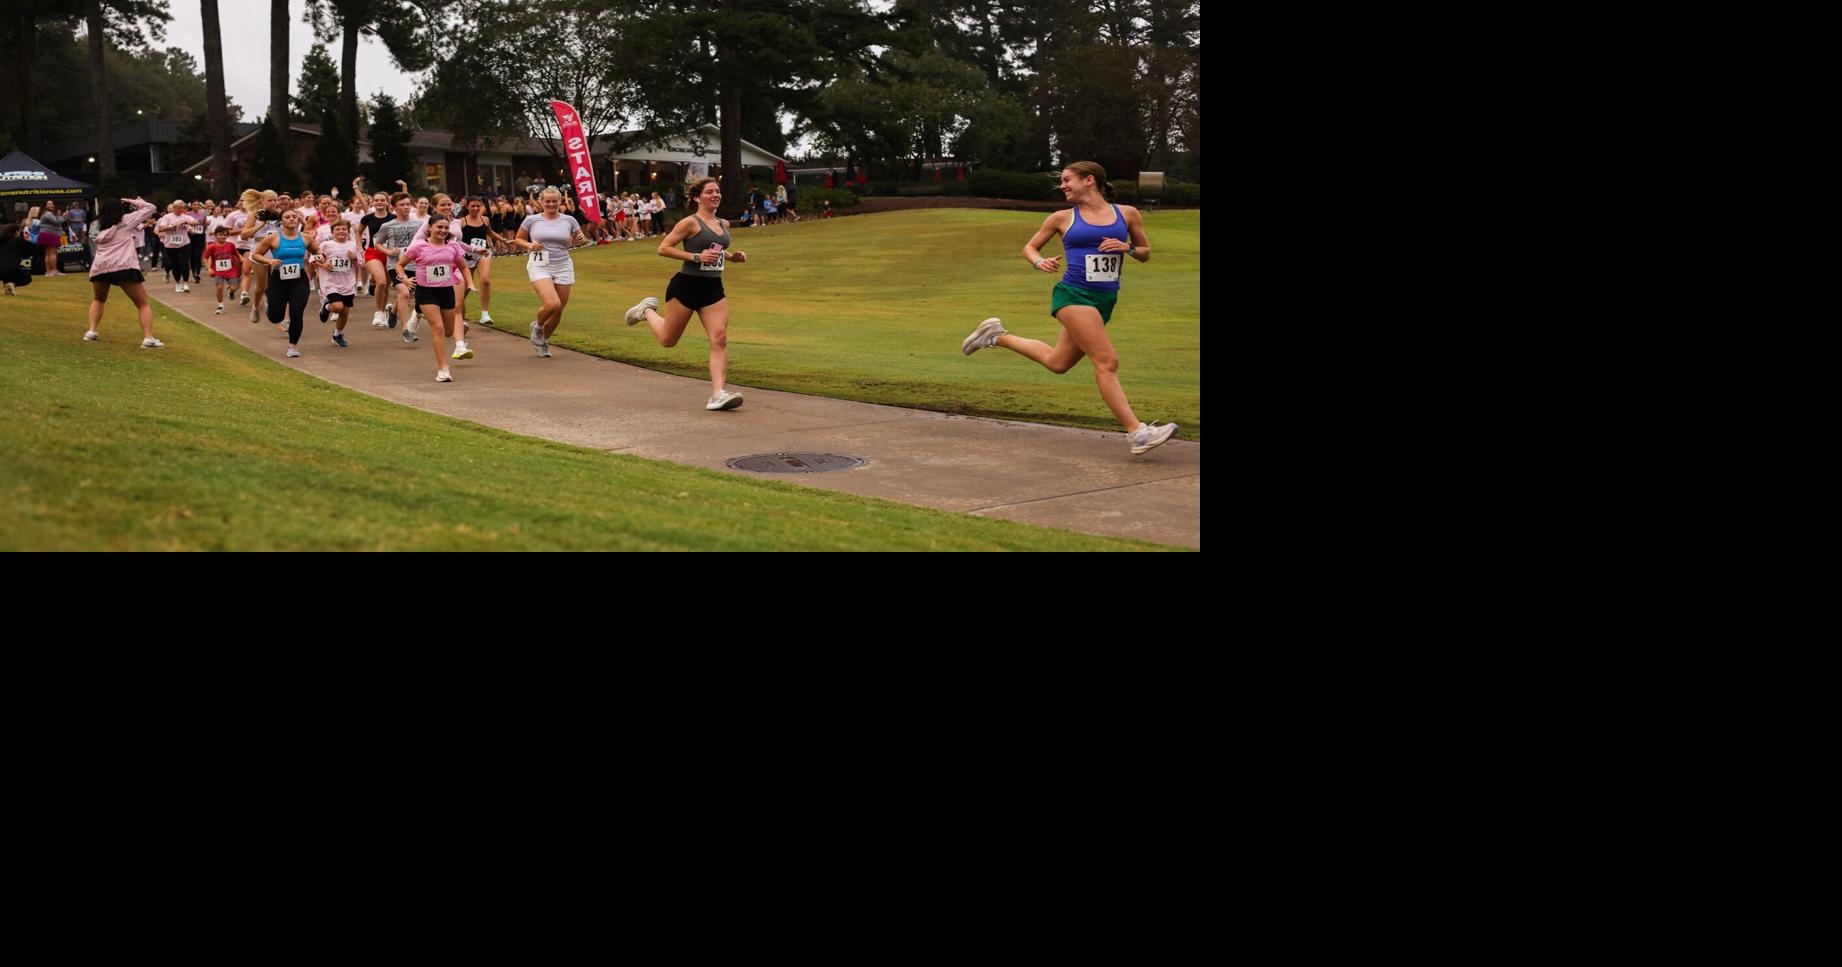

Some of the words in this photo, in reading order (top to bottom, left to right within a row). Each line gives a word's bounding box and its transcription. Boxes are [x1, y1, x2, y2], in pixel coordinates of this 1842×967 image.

[533, 252, 543, 261] 71
[334, 259, 349, 268] 134
[1093, 257, 1117, 273] 138
[283, 265, 298, 275] 147
[433, 266, 445, 276] 43
